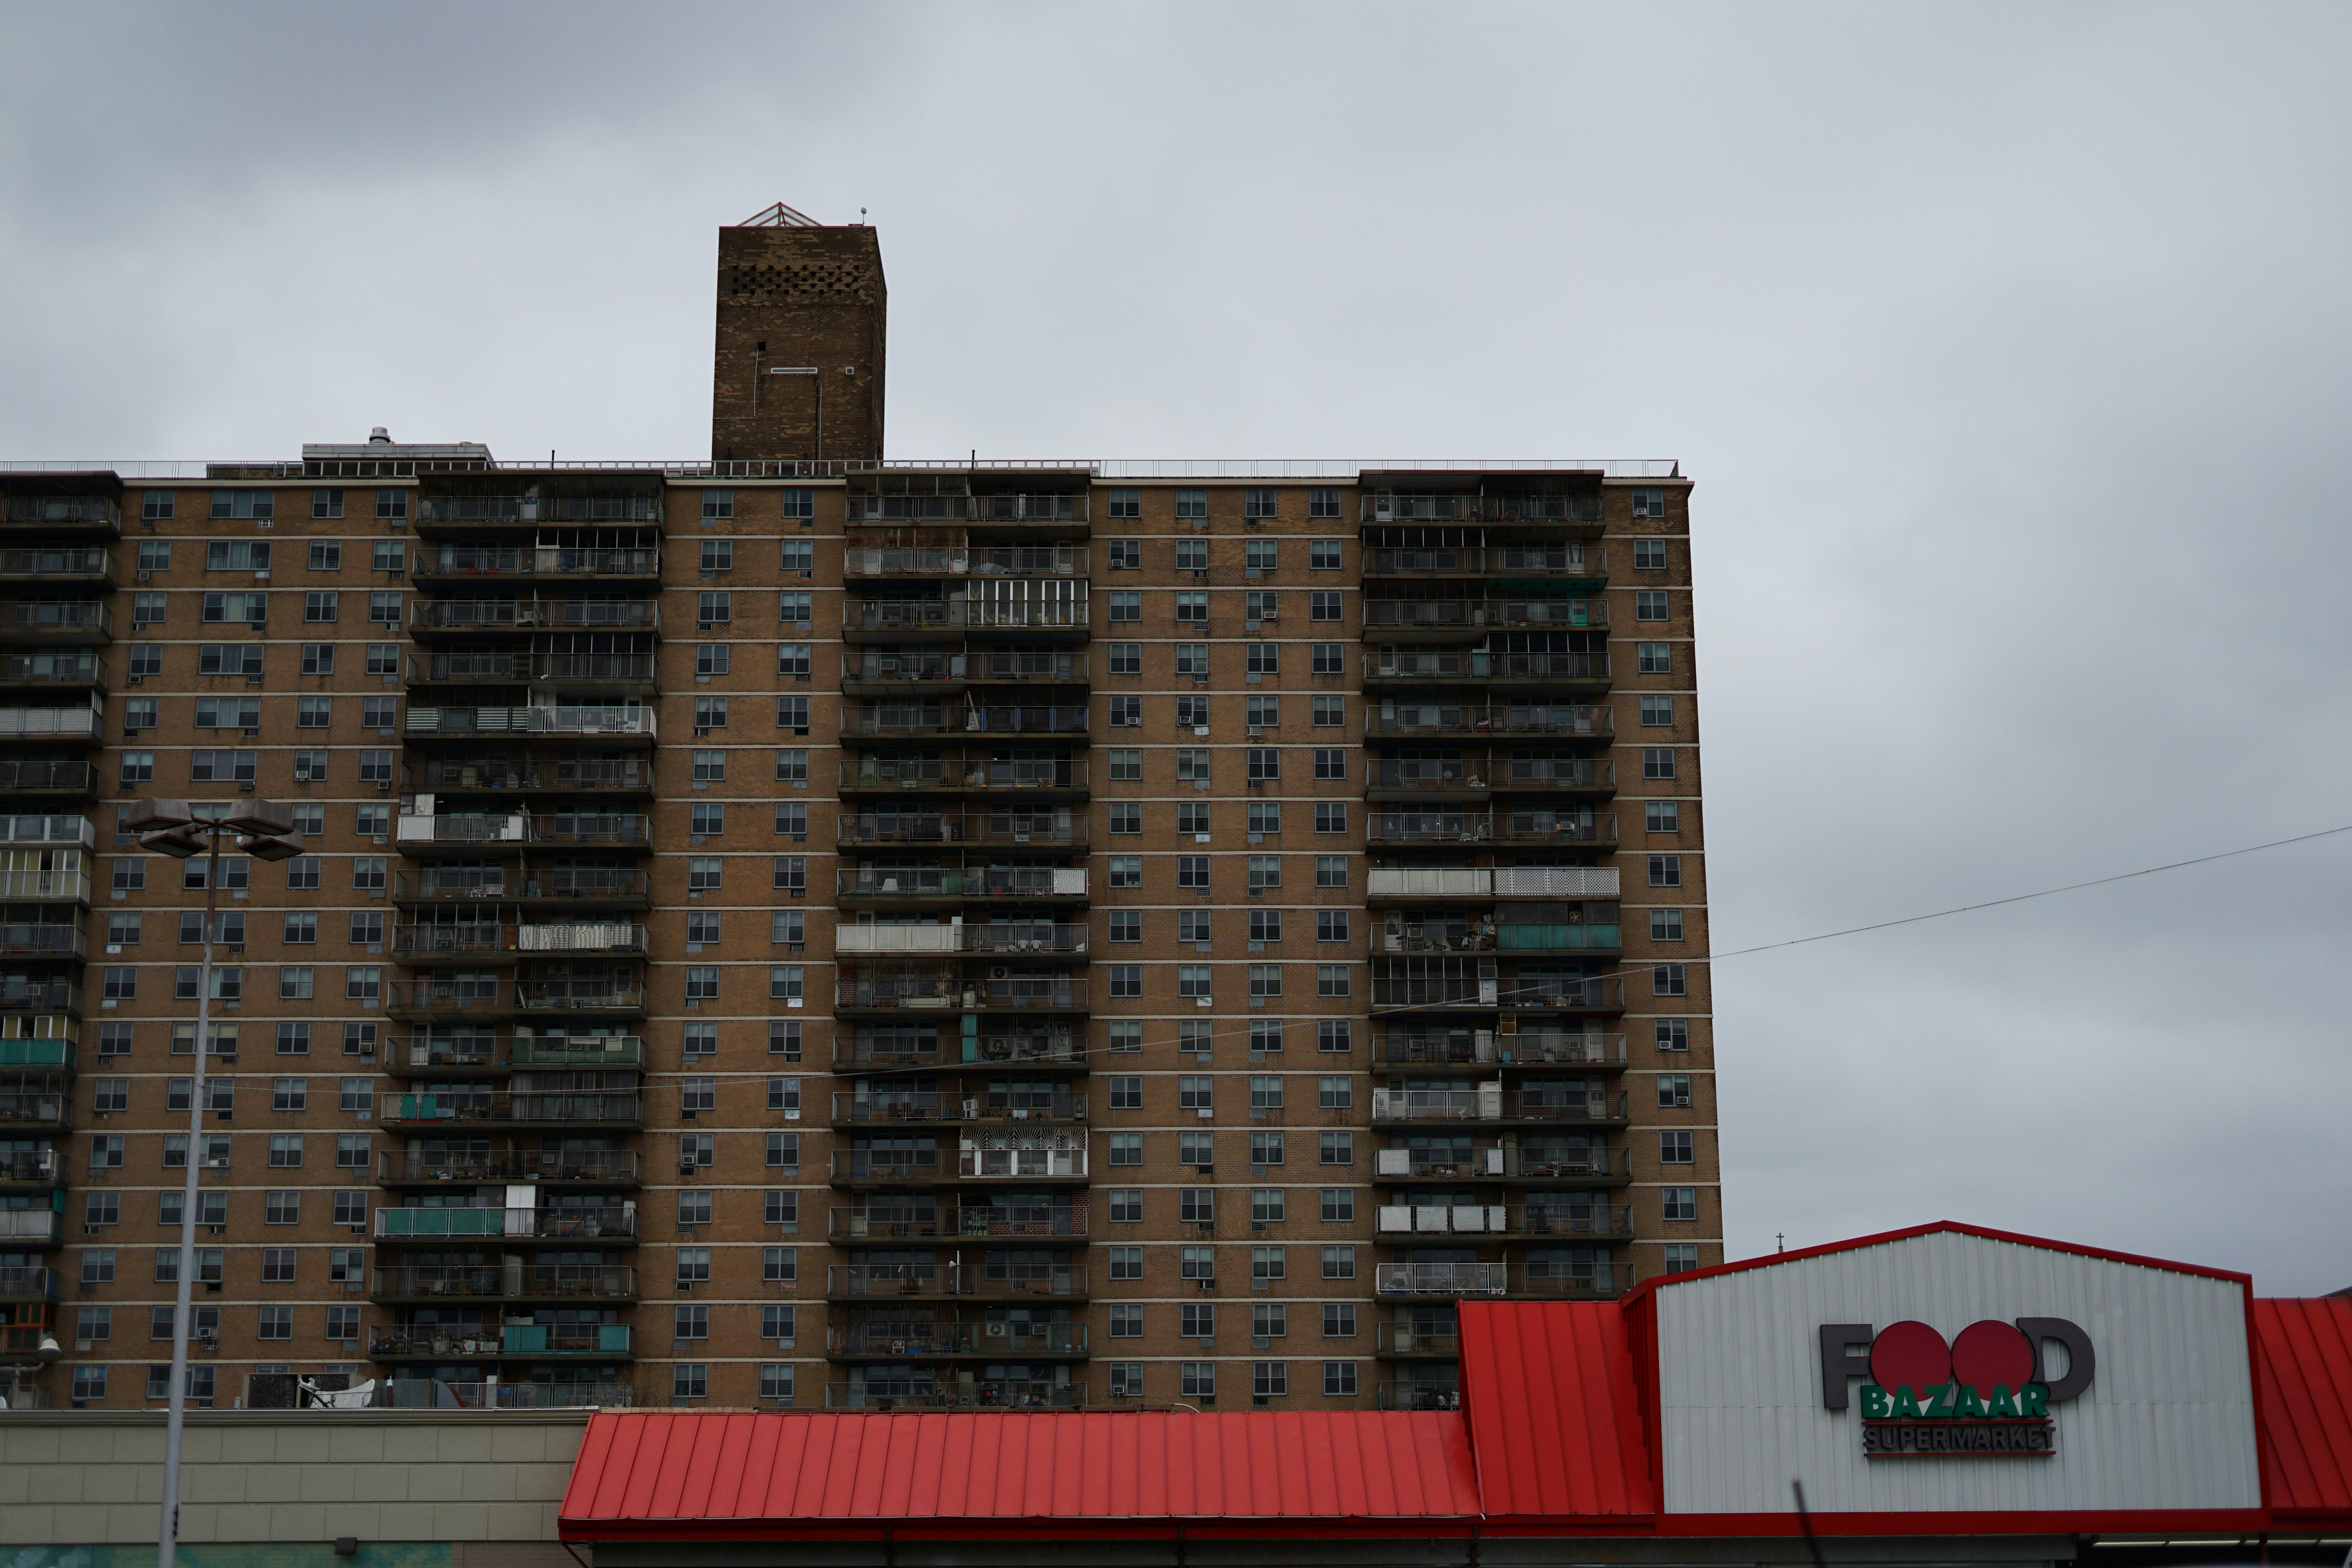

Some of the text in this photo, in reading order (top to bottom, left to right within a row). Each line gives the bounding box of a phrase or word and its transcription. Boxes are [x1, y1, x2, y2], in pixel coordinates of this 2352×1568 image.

[1820, 1317, 2096, 1408] FOOD
[1860, 1384, 2051, 1417] BAZAAR
[1863, 1427, 2056, 1449] SUPERMARKET
